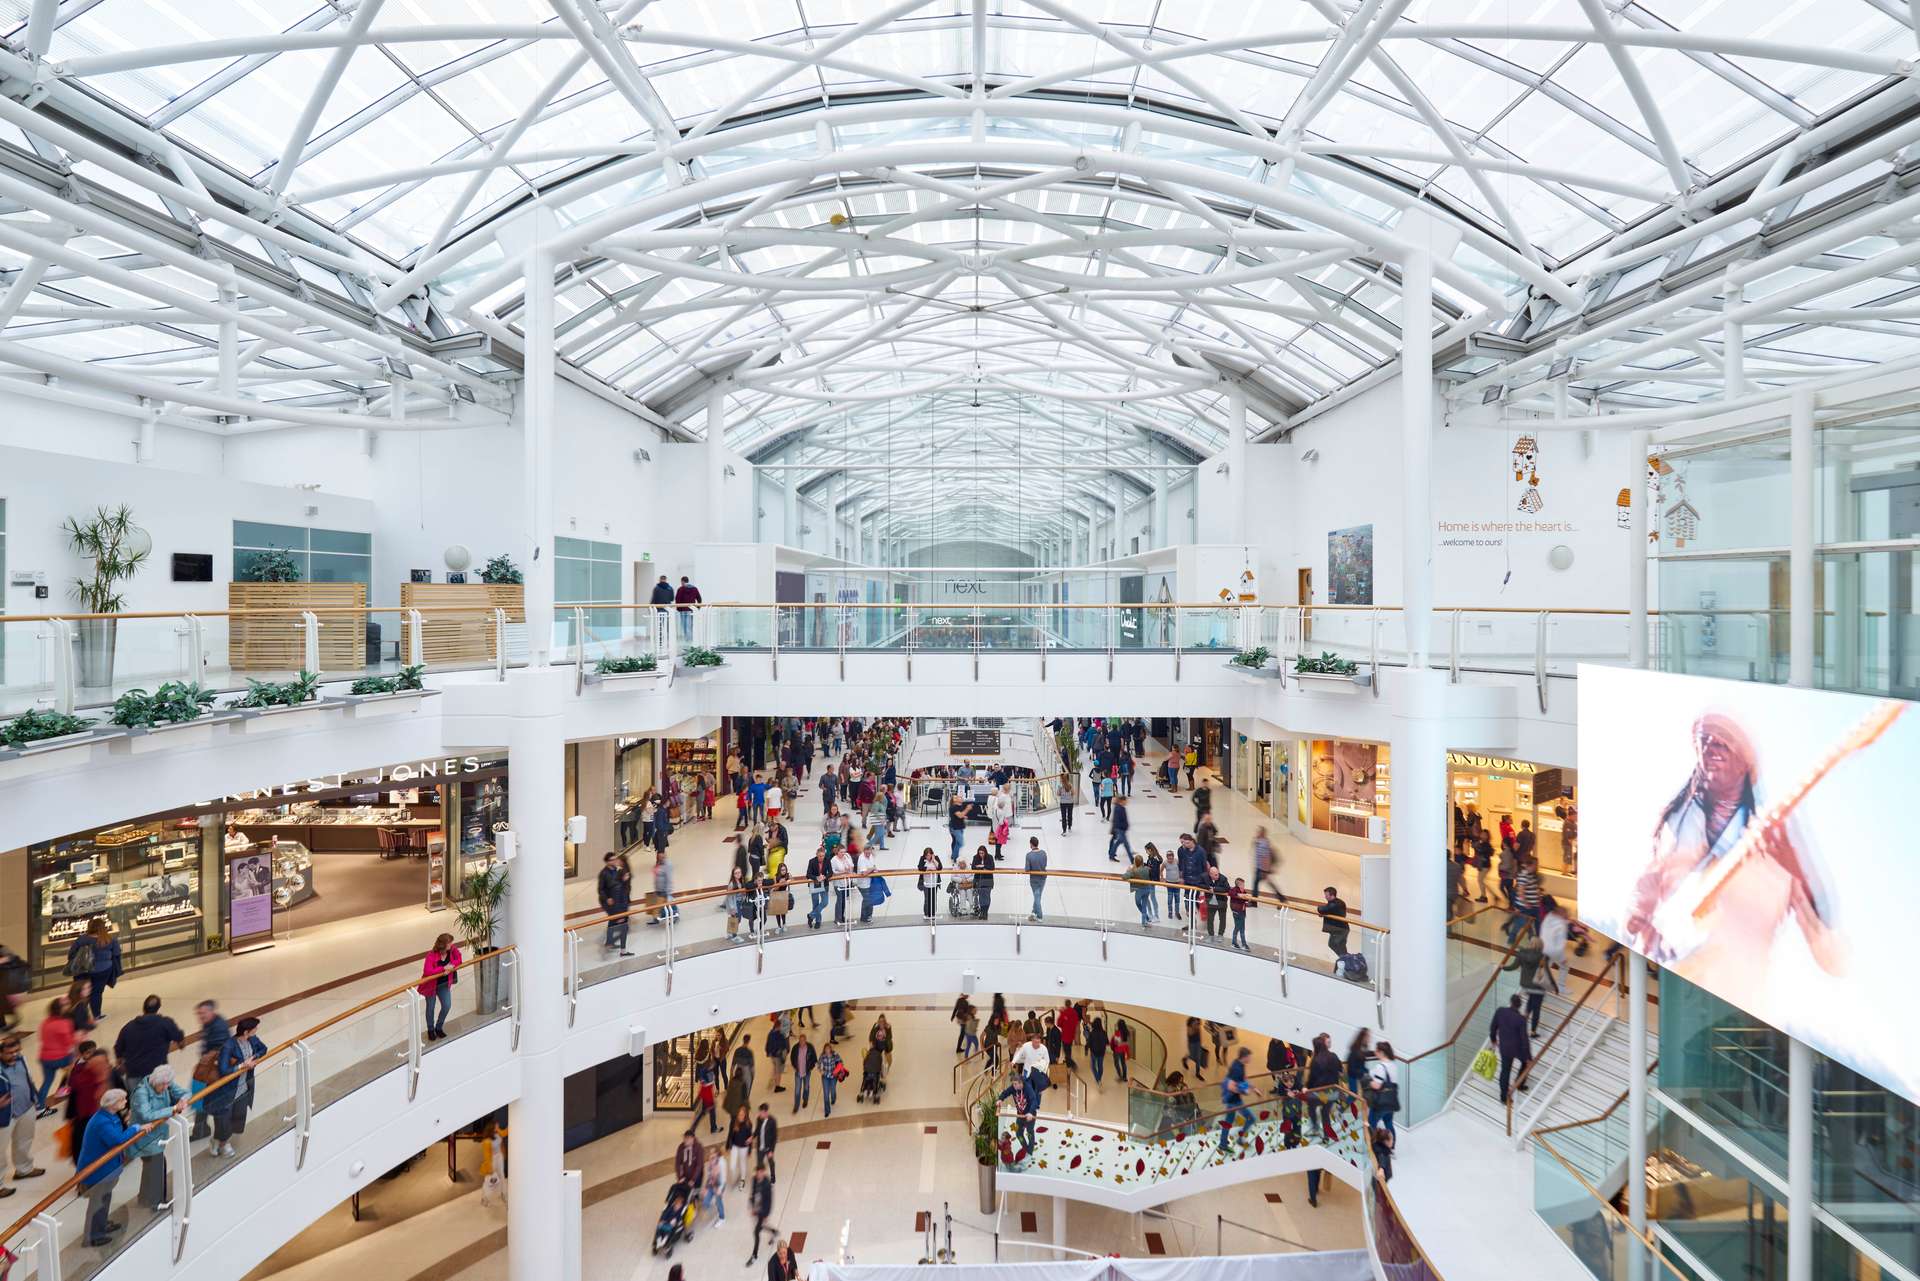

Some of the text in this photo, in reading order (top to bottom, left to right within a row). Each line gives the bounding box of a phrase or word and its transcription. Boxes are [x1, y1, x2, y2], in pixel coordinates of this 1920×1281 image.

[1438, 521, 1469, 532] Home
[1471, 521, 1479, 532] is
[1481, 521, 1513, 532] where
[1515, 521, 1532, 532] the
[1534, 521, 1562, 532] heart
[944, 578, 987, 593] next
[931, 616, 951, 625] next
[1446, 752, 1535, 774] ANDORA
[194, 756, 480, 807] NEST JONES
